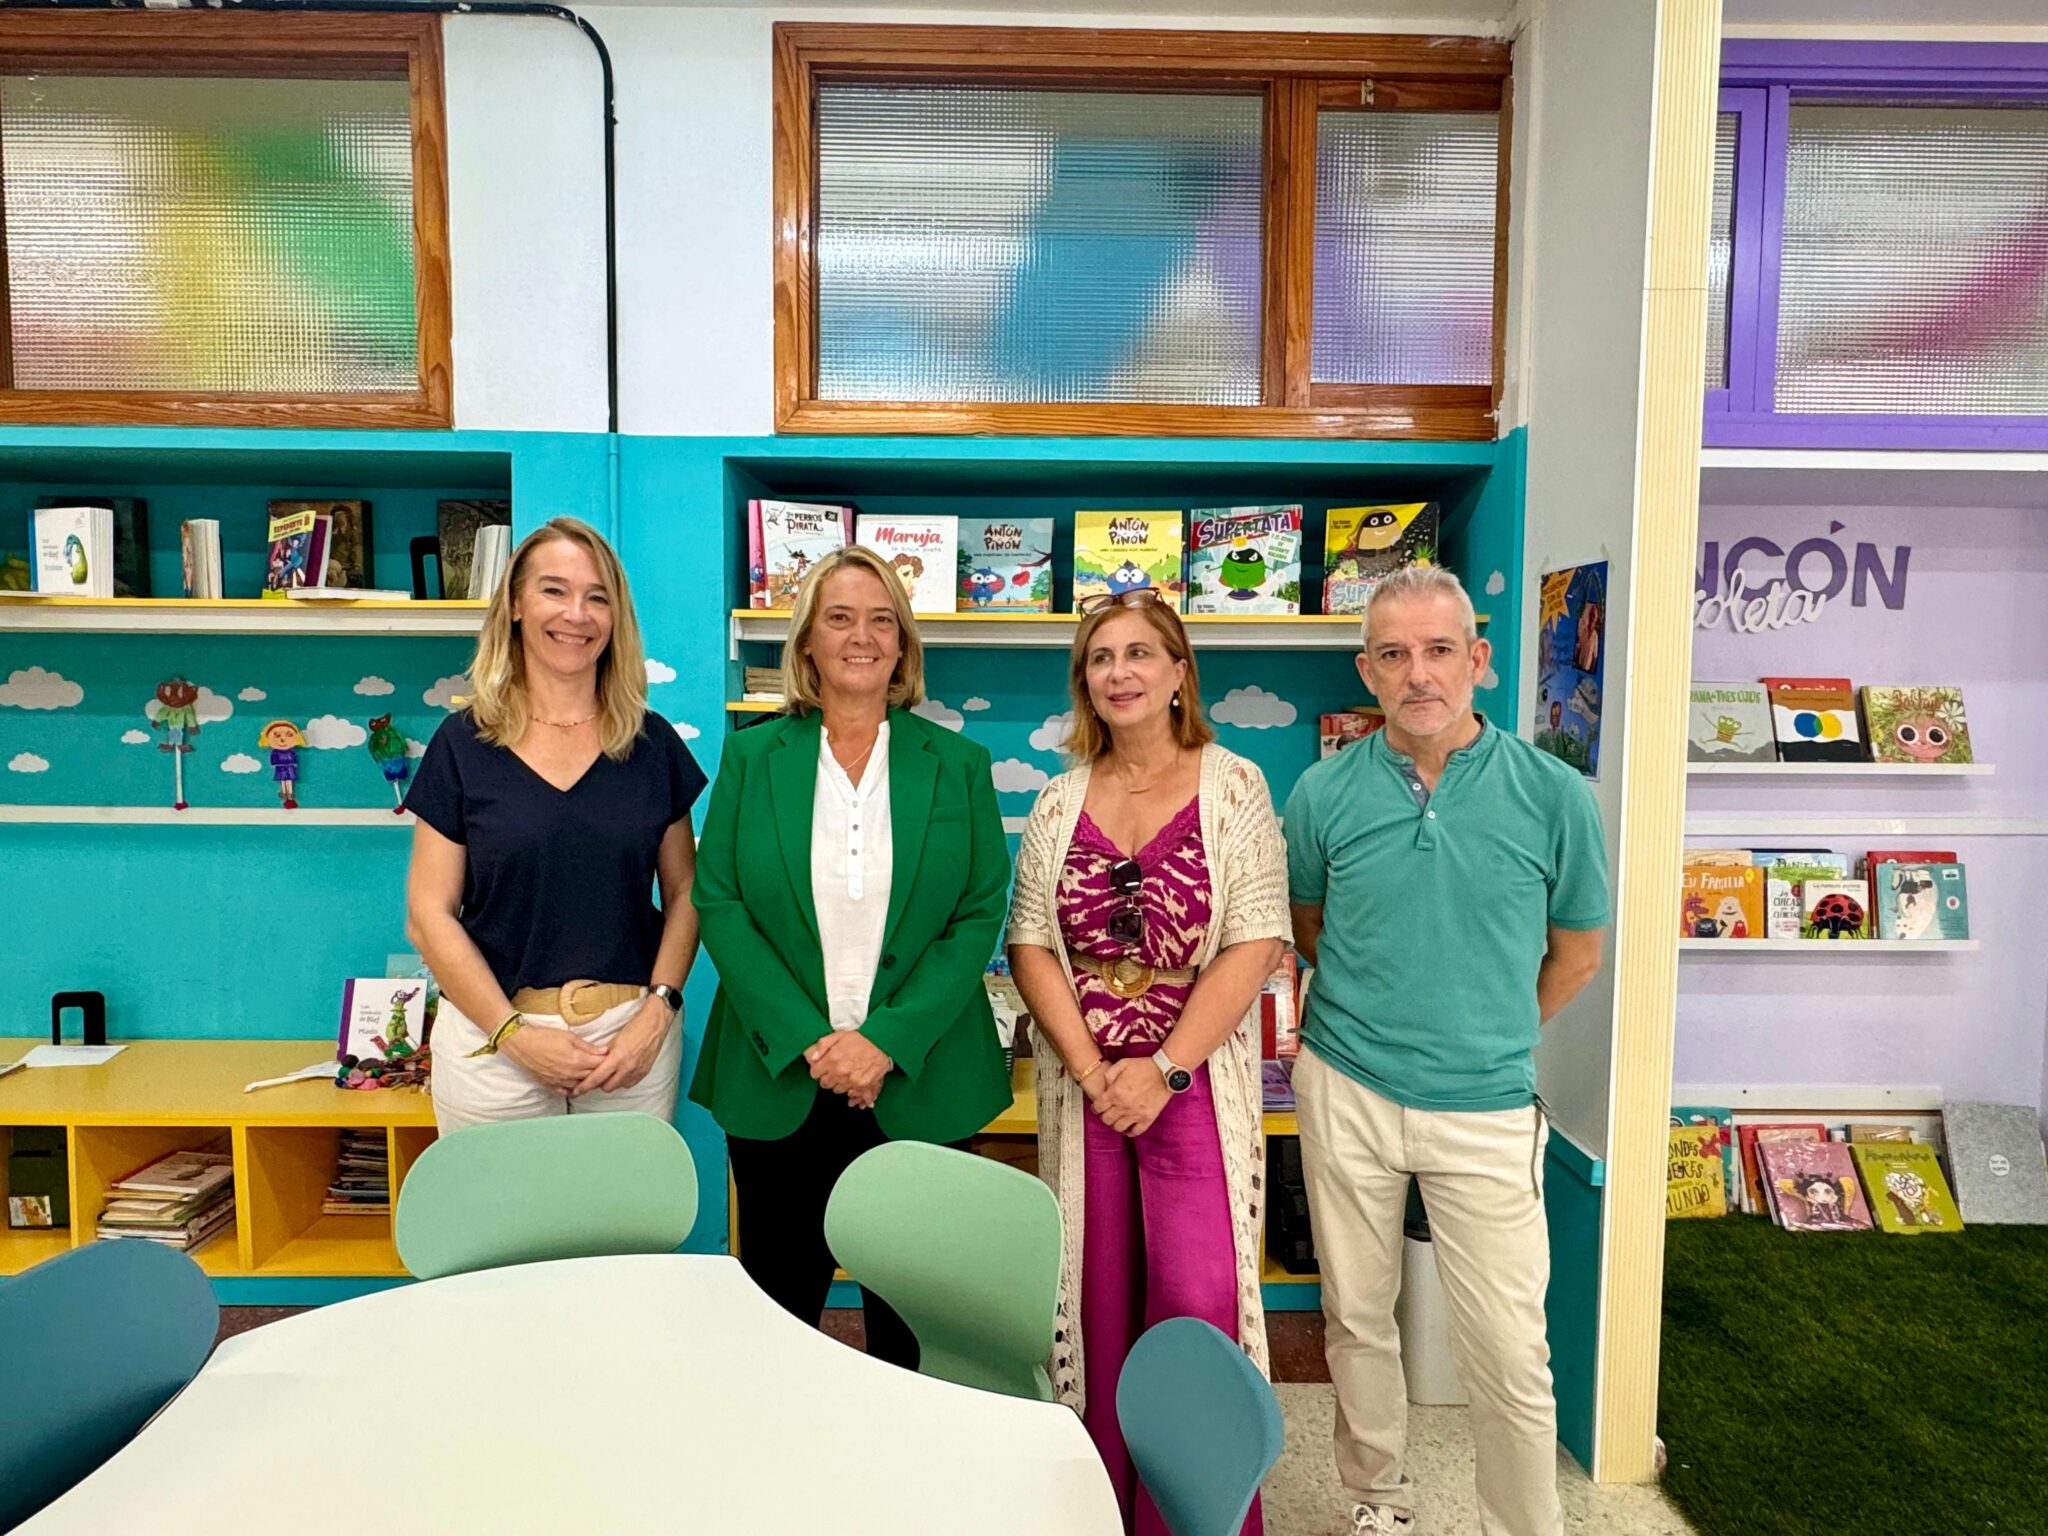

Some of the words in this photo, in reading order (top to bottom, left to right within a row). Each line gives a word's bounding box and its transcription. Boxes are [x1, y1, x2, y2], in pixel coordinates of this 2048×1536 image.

[794, 513, 822, 522] PERROS
[785, 518, 824, 534] PIRATA
[1701, 872, 1745, 889] FAMILIA
[1773, 898, 1801, 907] CHICAS
